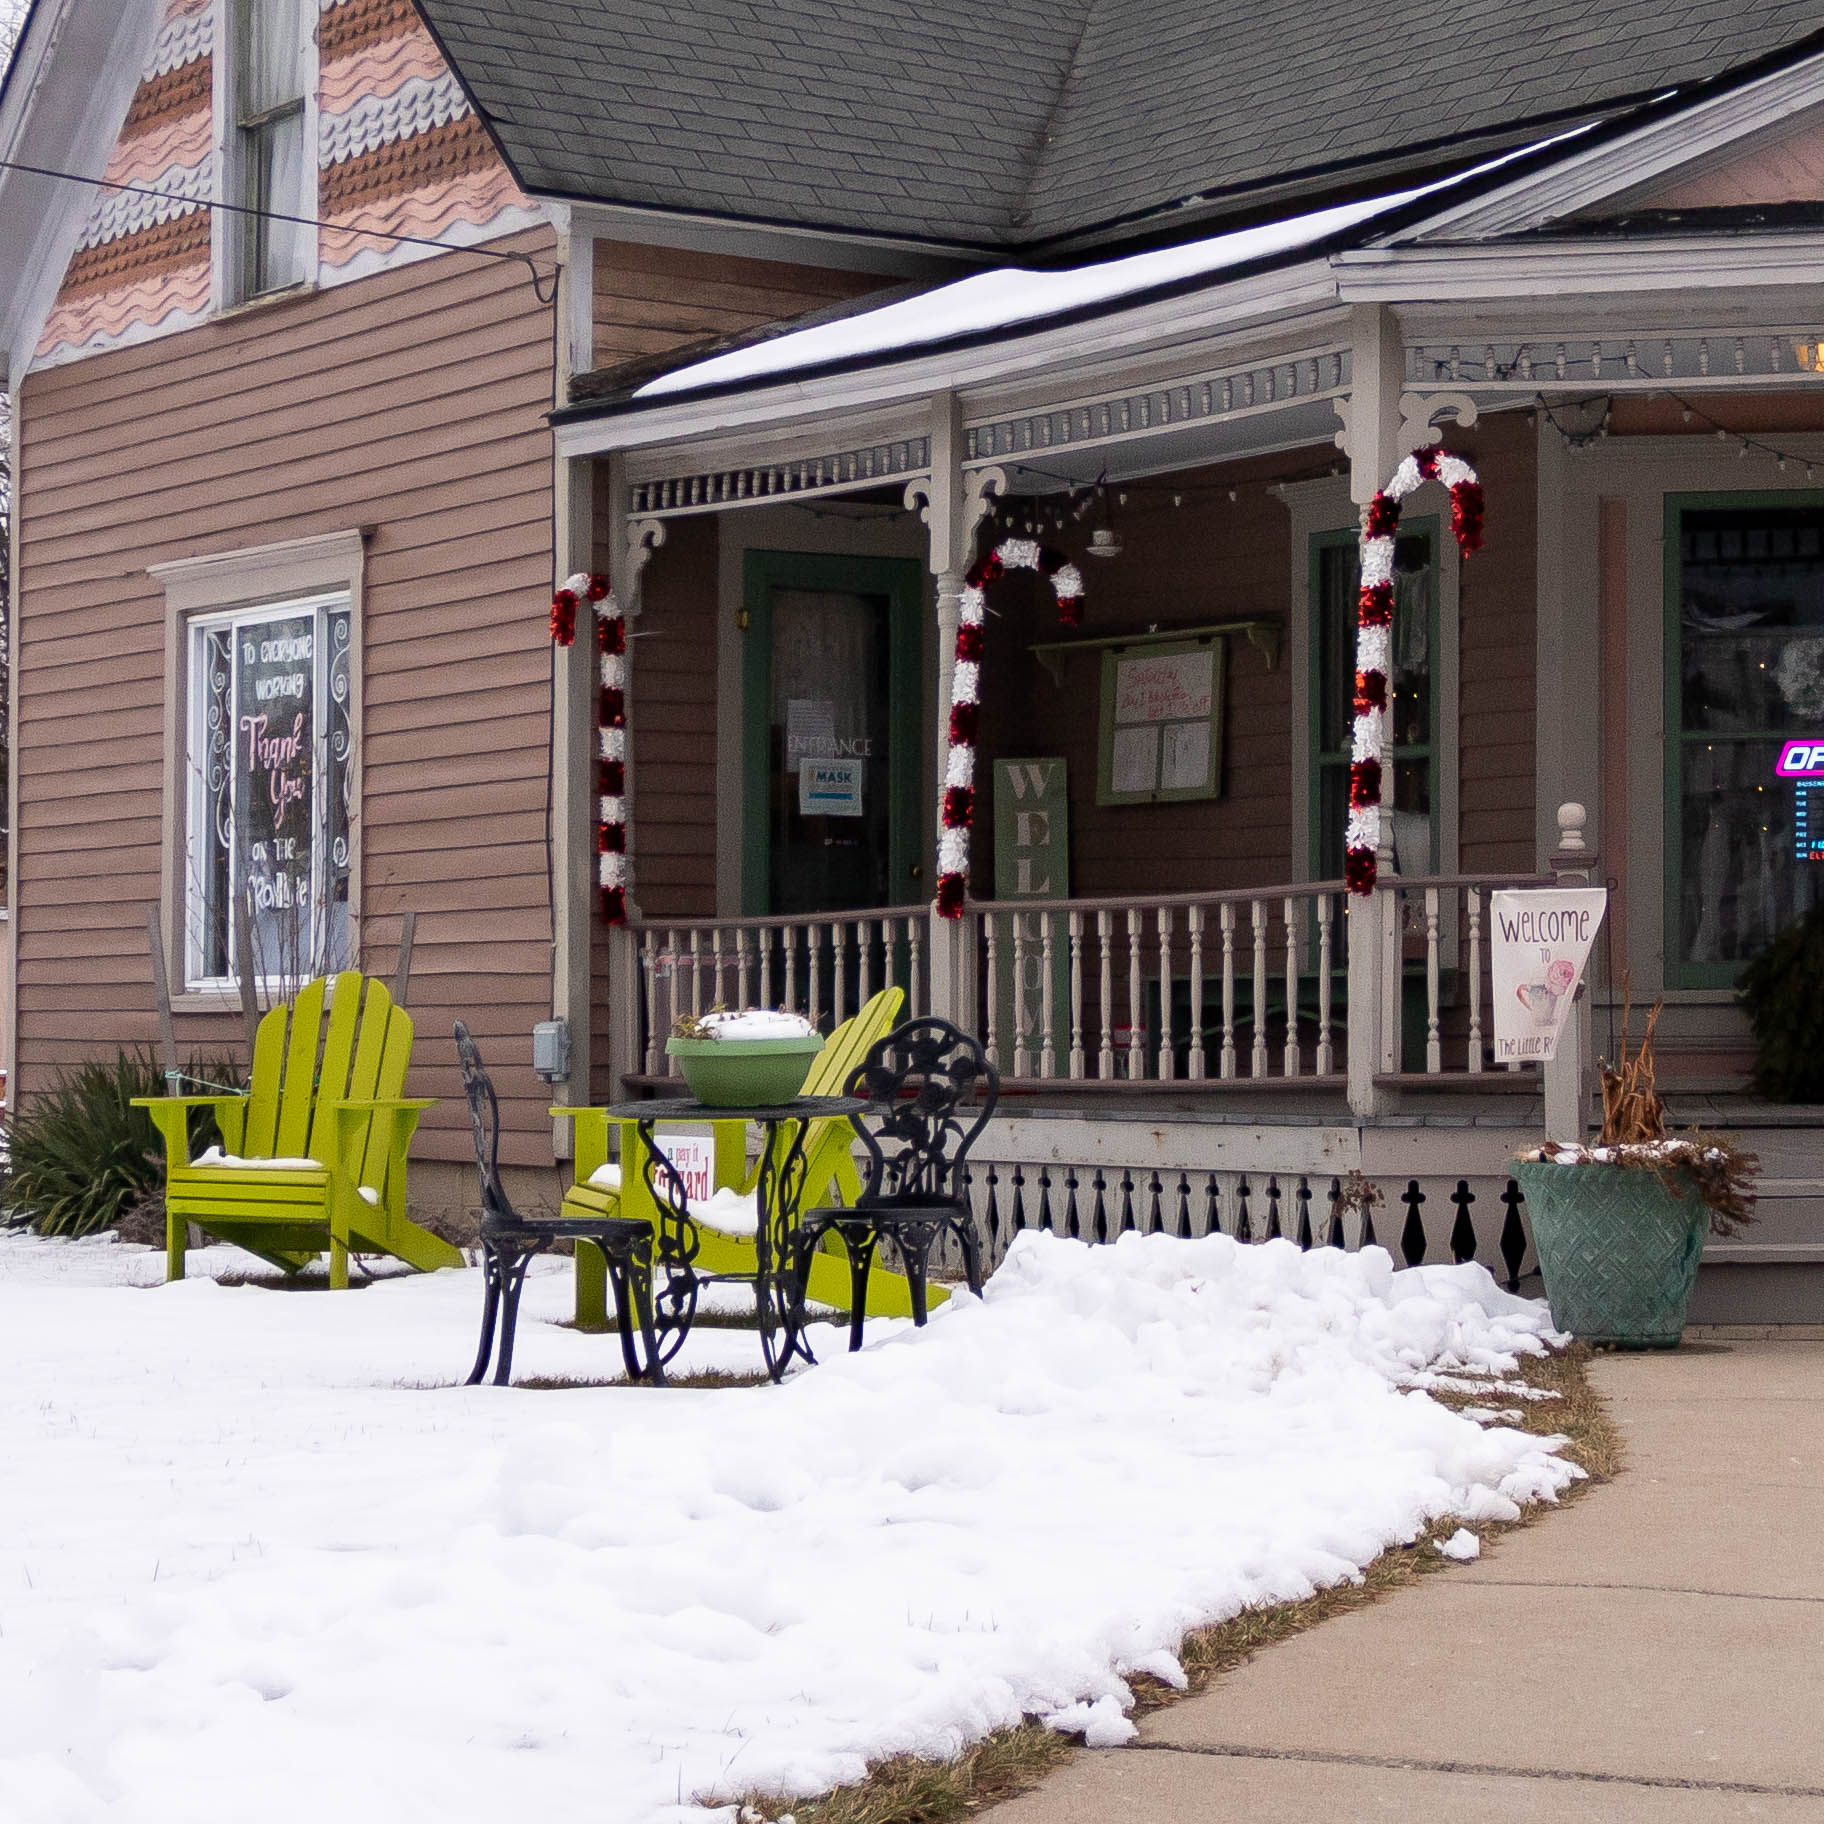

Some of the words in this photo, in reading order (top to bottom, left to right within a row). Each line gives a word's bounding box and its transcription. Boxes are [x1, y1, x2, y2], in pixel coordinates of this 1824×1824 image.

[240, 713, 303, 772] Thank
[788, 736, 873, 756] ENTRANCE
[816, 771, 853, 784] MASK
[676, 1147, 690, 1168] pay
[693, 1142, 698, 1162] it
